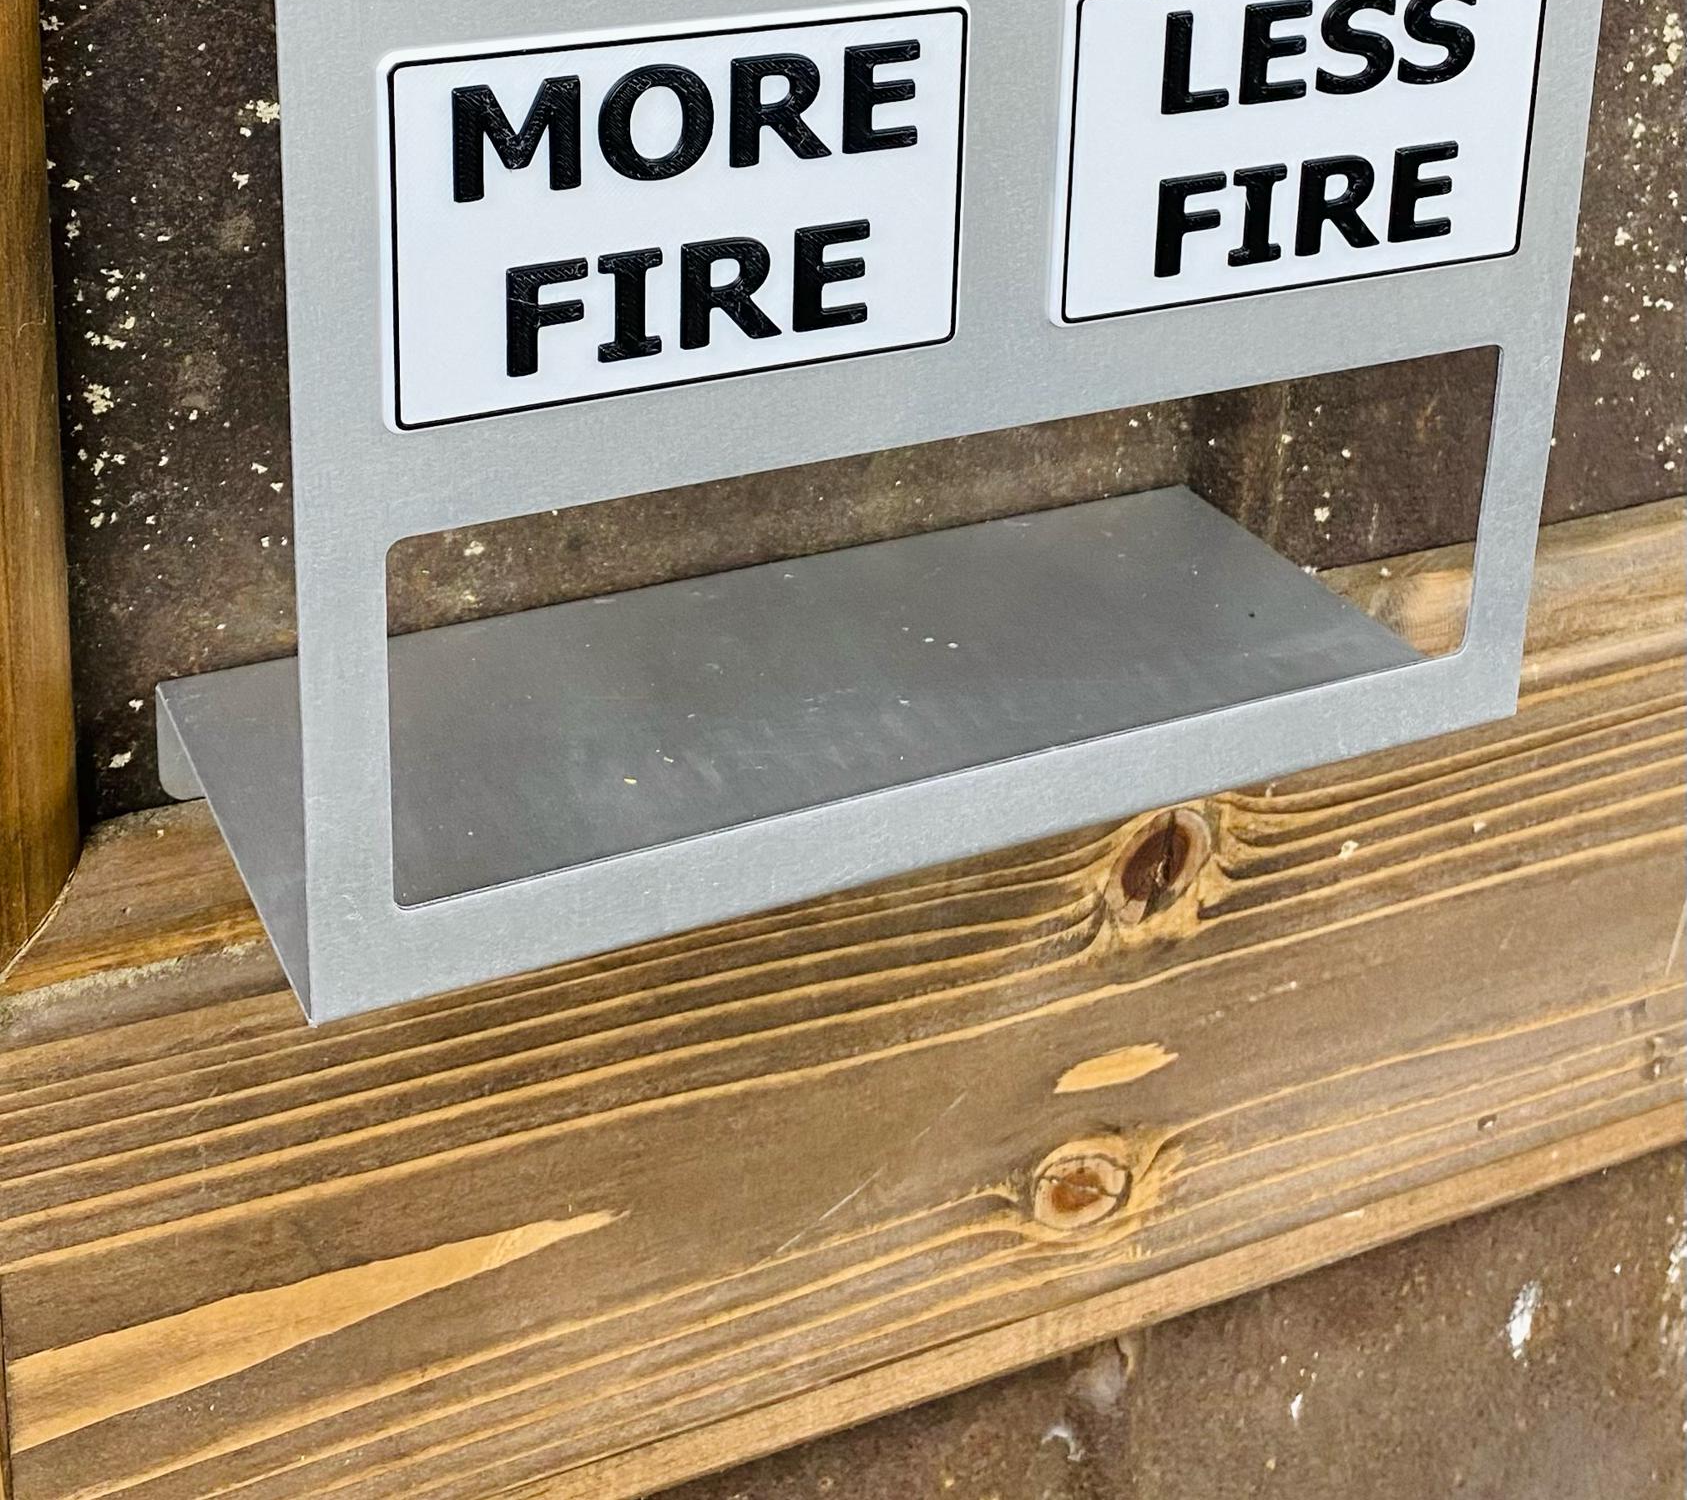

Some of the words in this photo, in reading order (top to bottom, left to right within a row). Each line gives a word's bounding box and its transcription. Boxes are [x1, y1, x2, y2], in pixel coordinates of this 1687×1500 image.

[452, 38, 922, 204] MORE
[1153, 140, 1460, 278] FIRE
[505, 218, 871, 378] FIRE
